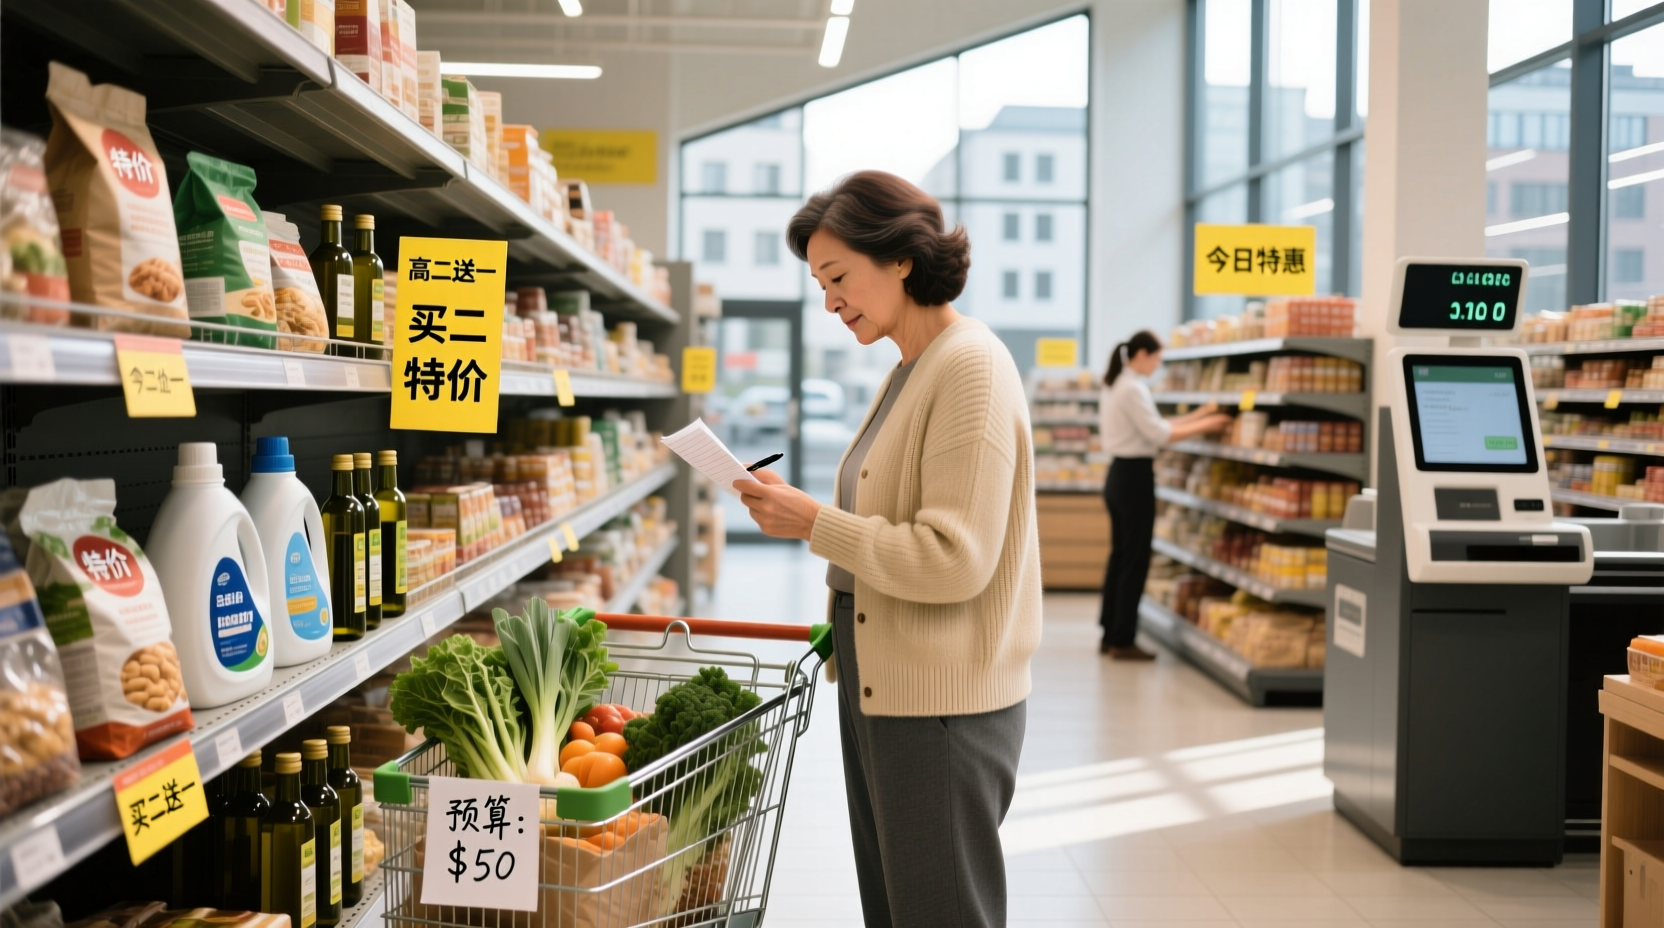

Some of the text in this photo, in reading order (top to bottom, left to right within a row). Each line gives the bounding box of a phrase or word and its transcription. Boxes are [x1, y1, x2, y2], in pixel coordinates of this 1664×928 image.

[110, 146, 154, 185] 特价
[409, 256, 497, 283] 高二送一
[1206, 245, 1306, 275] 今日特惠
[409, 304, 487, 344] 买二
[404, 357, 488, 403] 特价
[81, 547, 132, 581] 特价
[129, 778, 195, 837] 买二送一
[446, 794, 524, 841] 预算:
[447, 839, 515, 884] $50
